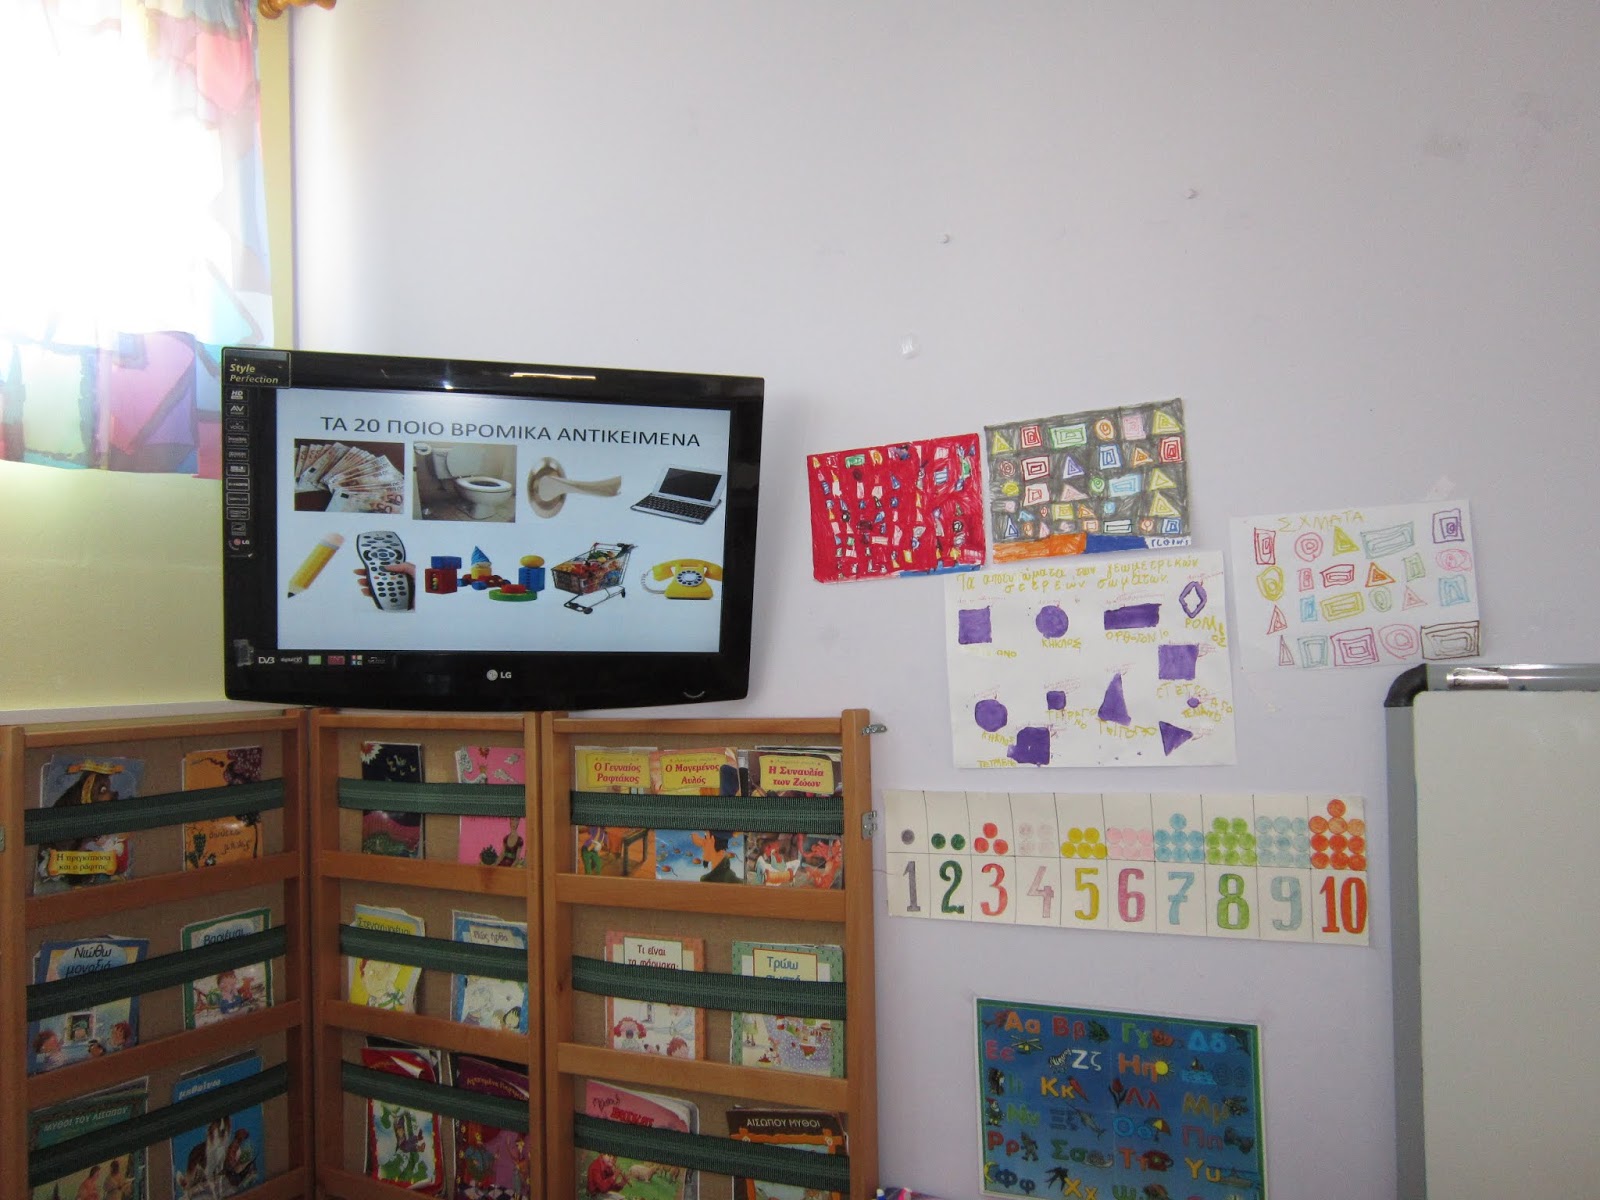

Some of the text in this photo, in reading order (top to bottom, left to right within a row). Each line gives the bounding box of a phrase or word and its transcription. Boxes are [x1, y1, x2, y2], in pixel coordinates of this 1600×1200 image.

[230, 363, 256, 374] Style
[230, 374, 279, 384] Perfection
[320, 416, 701, 447] ΤΑ 20 ΠΟΙΟ ΒΡΟΜΙΚΑ ΑΝΤΙΚΕΙΜΕΝΑ
[500, 671, 512, 679] LG
[594, 762, 641, 773] Ο Γενναίος
[665, 763, 720, 774] Ο Μαγεμένος
[768, 766, 824, 777] Η Συναυλία
[596, 773, 640, 784] Ραφτάκος
[681, 776, 706, 785] Αυλός
[772, 777, 821, 787] των Ζώων
[903, 860, 1368, 935] 1 2 3 4 5 6 7 8 9 10
[74, 944, 112, 959] Νιώθω
[637, 945, 666, 956] Τι είναι
[65, 958, 112, 978] μοναξιά
[766, 956, 799, 972] Τρώω
[75, 1114, 91, 1125] ΤΟΥ
[746, 1118, 821, 1129] ΑΙΣΩΠΟΥ ΜΥΘΟΙ
